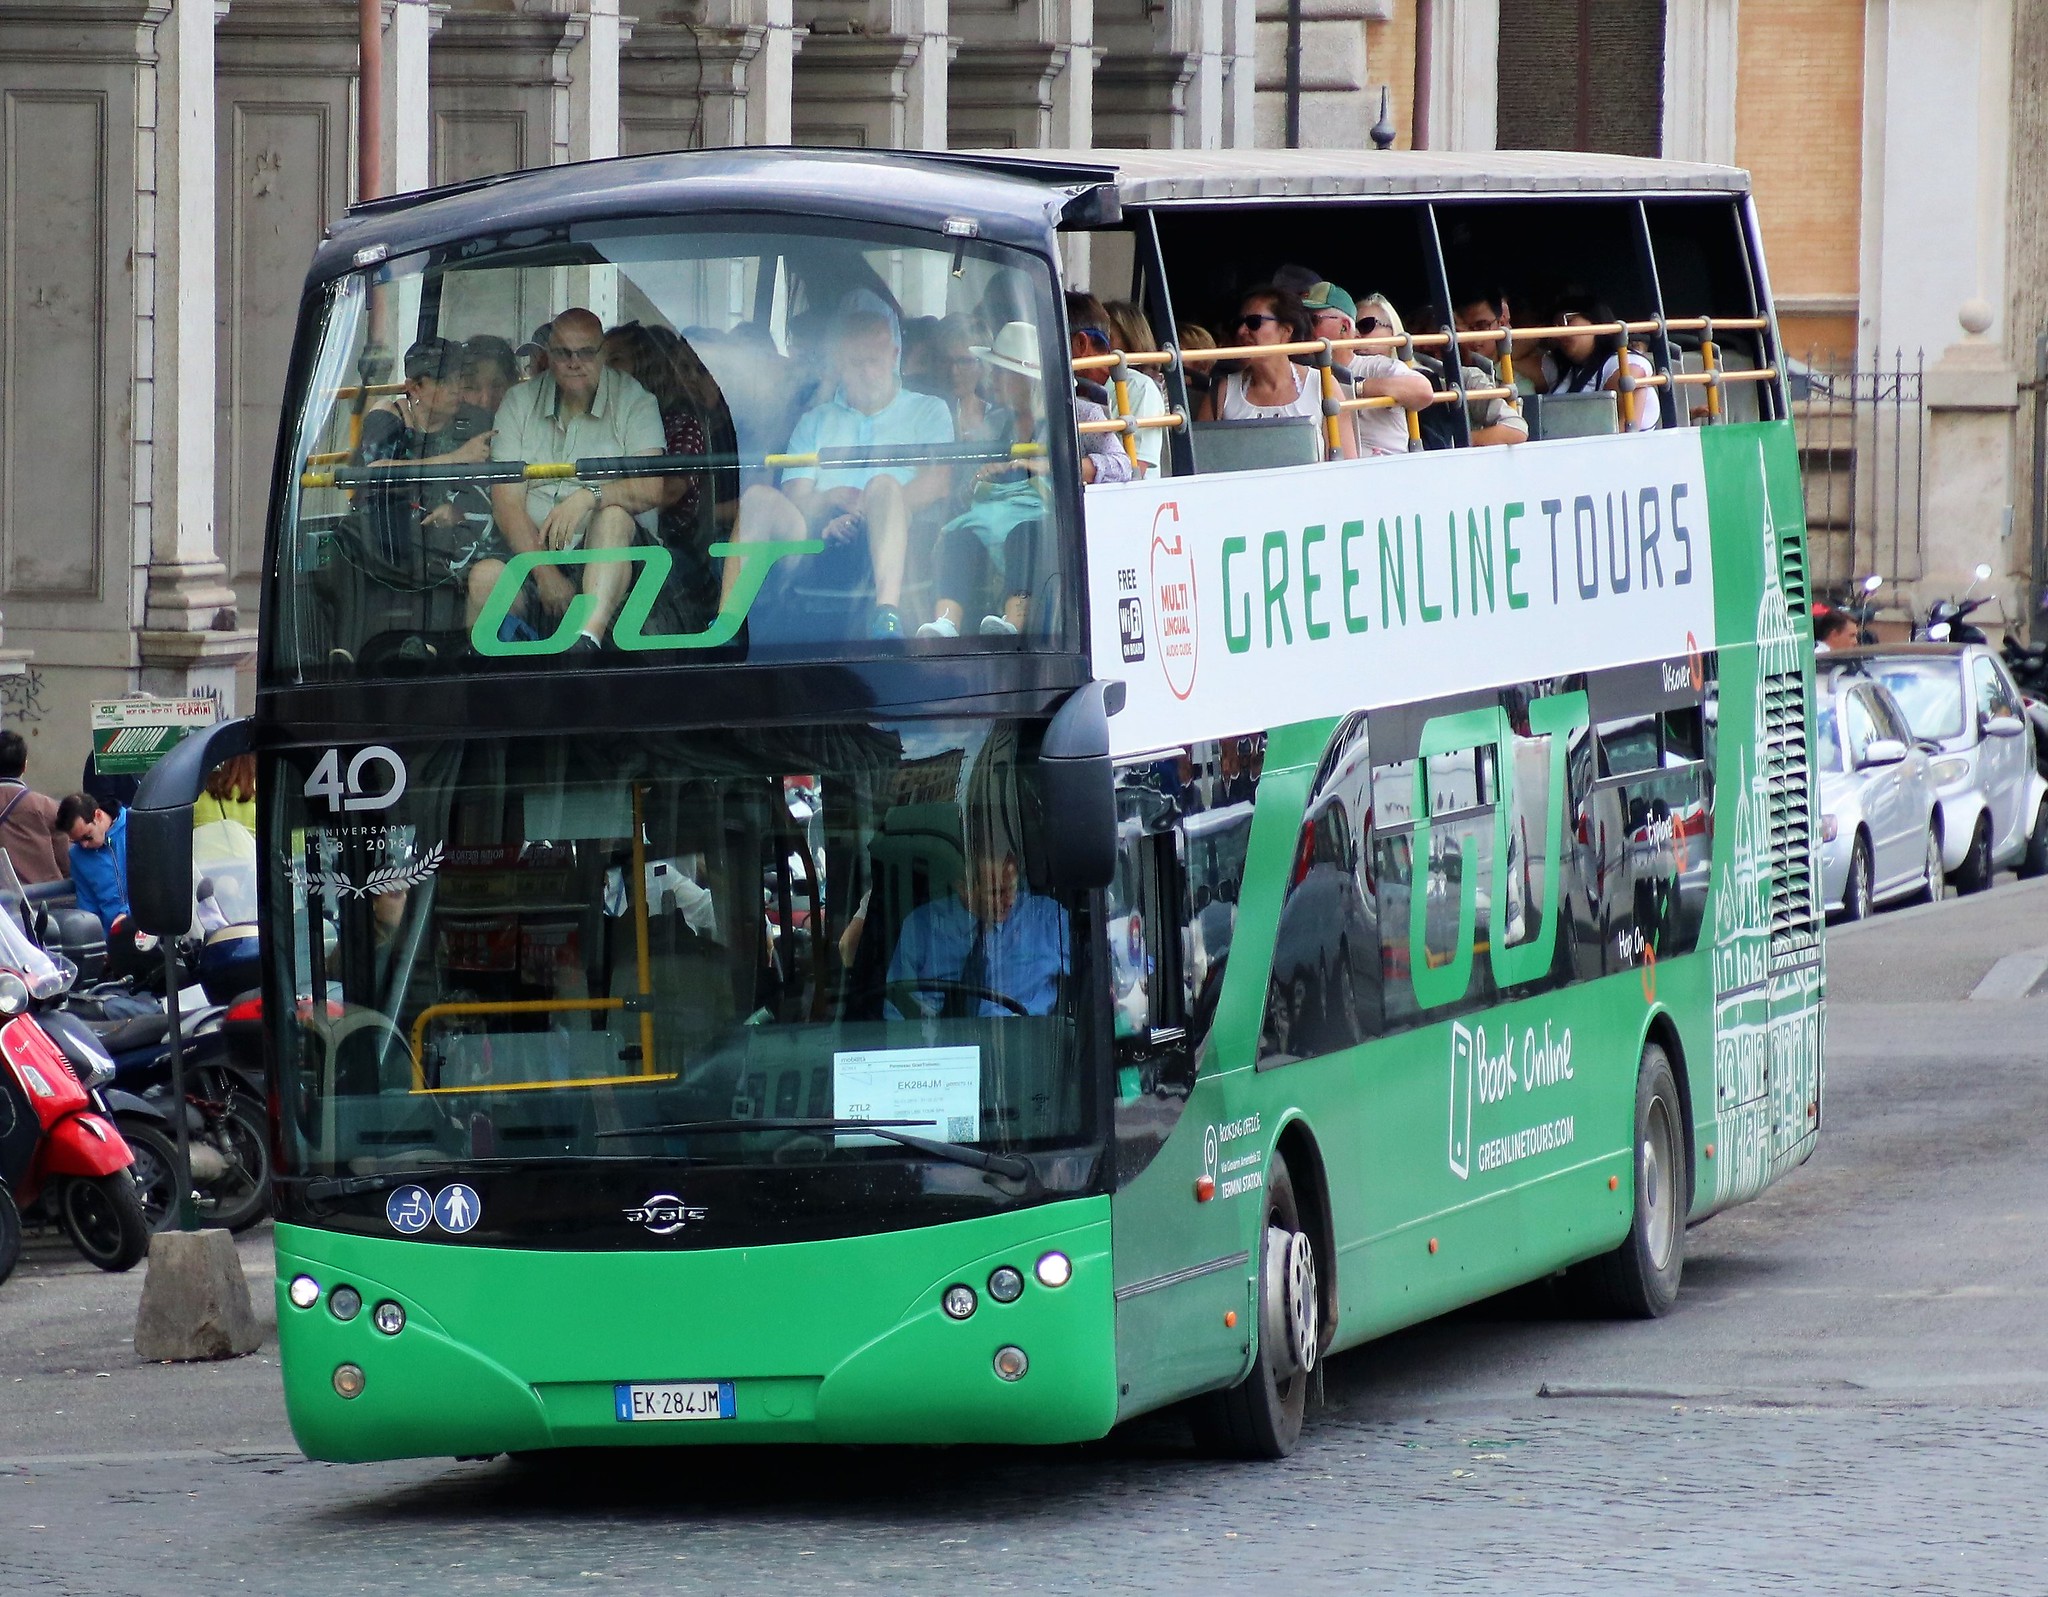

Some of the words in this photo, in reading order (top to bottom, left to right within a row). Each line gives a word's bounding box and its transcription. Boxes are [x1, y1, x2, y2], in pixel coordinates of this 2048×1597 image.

[1118, 568, 1137, 591] FREE
[1221, 501, 1530, 655] GREENLINE
[1541, 482, 1693, 606] TOURS
[1160, 583, 1189, 612] MULTI
[1119, 605, 1142, 634] WiFi
[1163, 615, 1190, 637] LINGUAL
[1662, 661, 1691, 693] Discover
[177, 706, 211, 715] TERMINI
[304, 745, 407, 812] 40
[305, 823, 408, 838] ANNIVERSARY
[1646, 808, 1674, 853] Explore
[1618, 928, 1633, 966] Hop
[1634, 926, 1646, 952] On
[1475, 1023, 1518, 1104] Book
[1523, 1017, 1574, 1093] Online
[897, 1079, 942, 1090] EK284JM
[848, 1103, 871, 1112] ZTL2
[1219, 1119, 1243, 1143] BOOKING
[1242, 1112, 1261, 1136] OFFICE
[1477, 1115, 1575, 1173] GREENLINETOURS.COM
[1242, 1171, 1263, 1193] STATION
